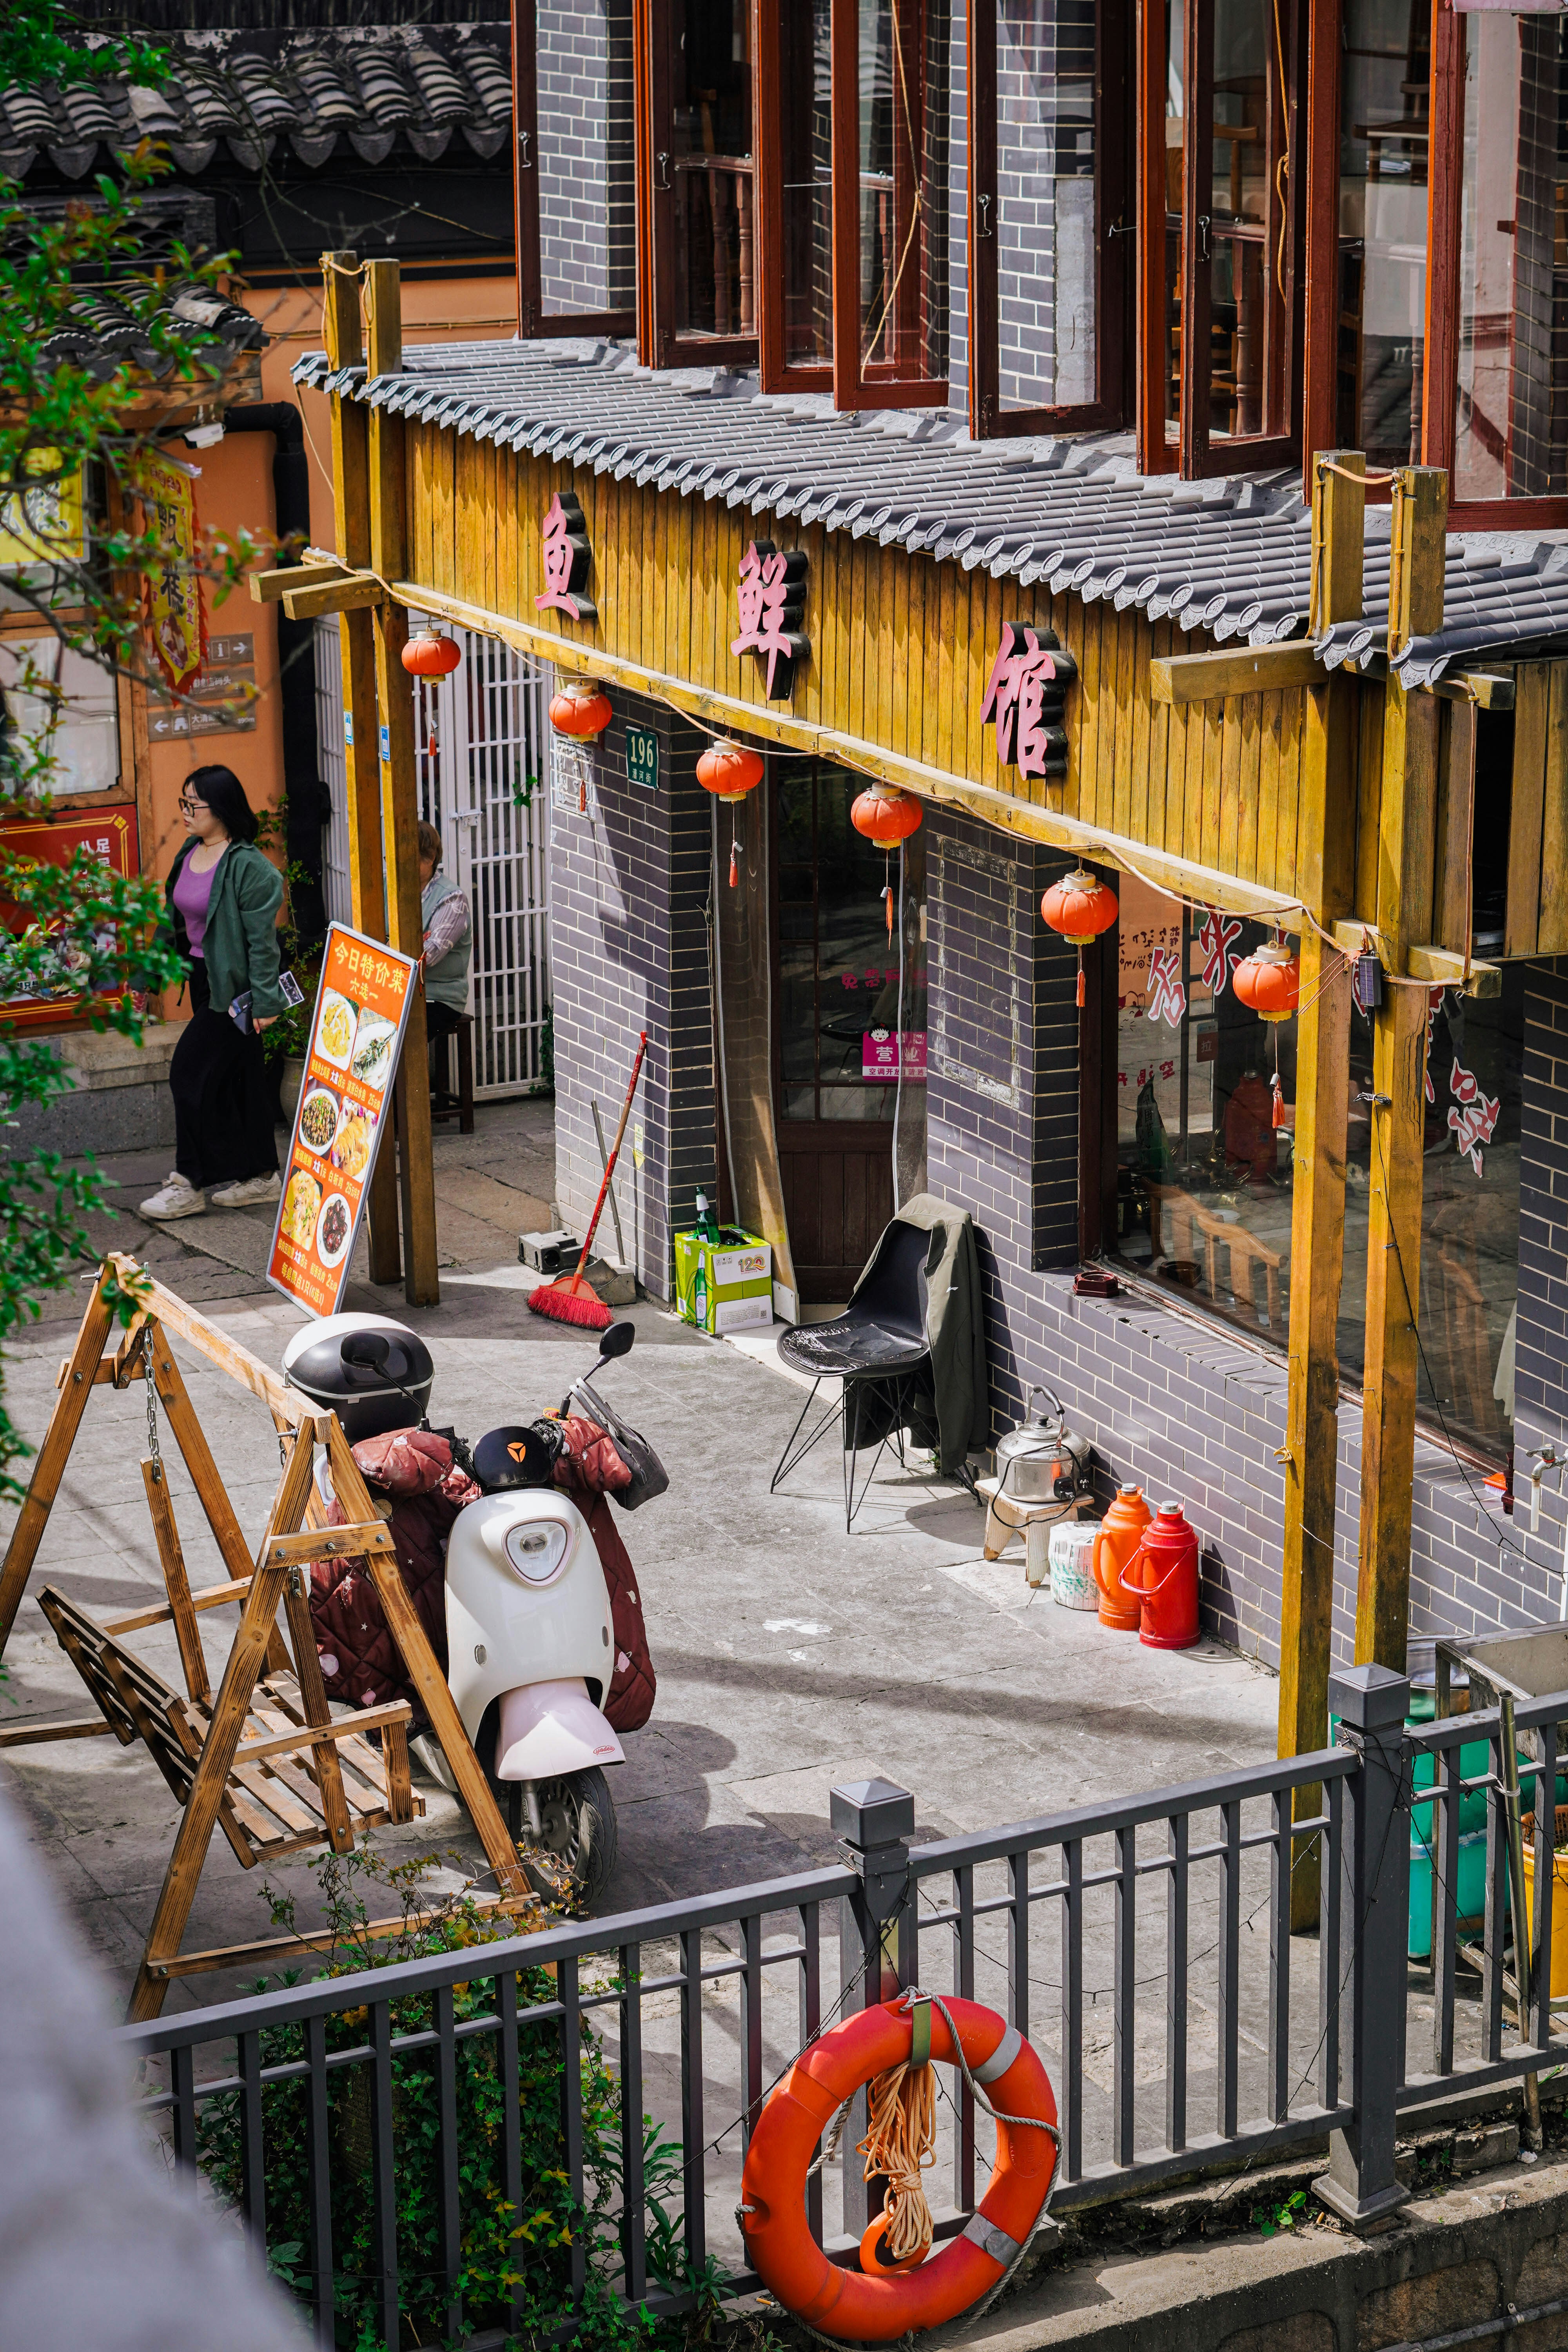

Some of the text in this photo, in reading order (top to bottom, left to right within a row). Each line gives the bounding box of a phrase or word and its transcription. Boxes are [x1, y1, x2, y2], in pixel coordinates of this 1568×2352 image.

[631, 735, 653, 768] 196
[632, 768, 651, 784] 漕河街
[334, 942, 404, 995] 今日特价菜
[350, 977, 378, 1001] 六选一
[346, 1080, 366, 1102] 清蒸白水鱼
[595, 1746, 614, 1755] yadea
